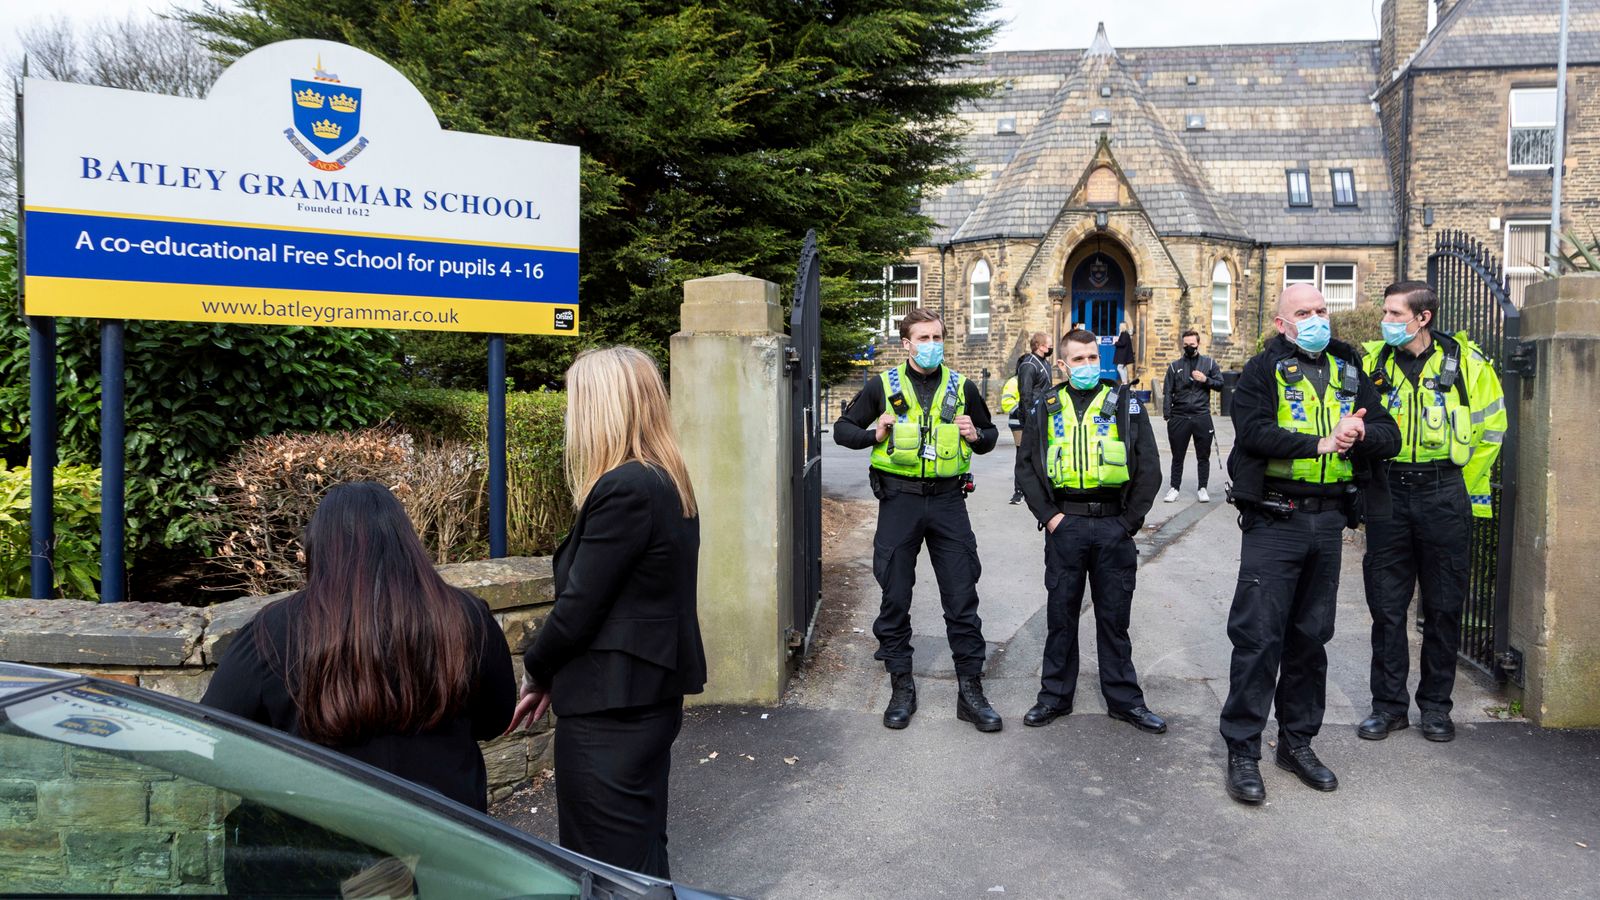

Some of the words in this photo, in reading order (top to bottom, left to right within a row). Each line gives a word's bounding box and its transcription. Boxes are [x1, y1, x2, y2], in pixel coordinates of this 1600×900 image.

[316, 160, 339, 170] NON
[80, 156, 227, 191] BATLEY
[239, 172, 413, 209] GRAMMAR
[423, 190, 541, 220] SCHOOL
[297, 202, 343, 215] Founded
[347, 207, 370, 217] 1612
[75, 230, 94, 251] A
[100, 235, 277, 262] co-educational
[283, 244, 328, 266] Free
[334, 248, 402, 271] School
[407, 253, 434, 272] for
[439, 258, 496, 279] pupils
[499, 261, 512, 277] 4
[515, 262, 544, 279] -16
[202, 299, 459, 324] www.batleygrammar.co.uk
